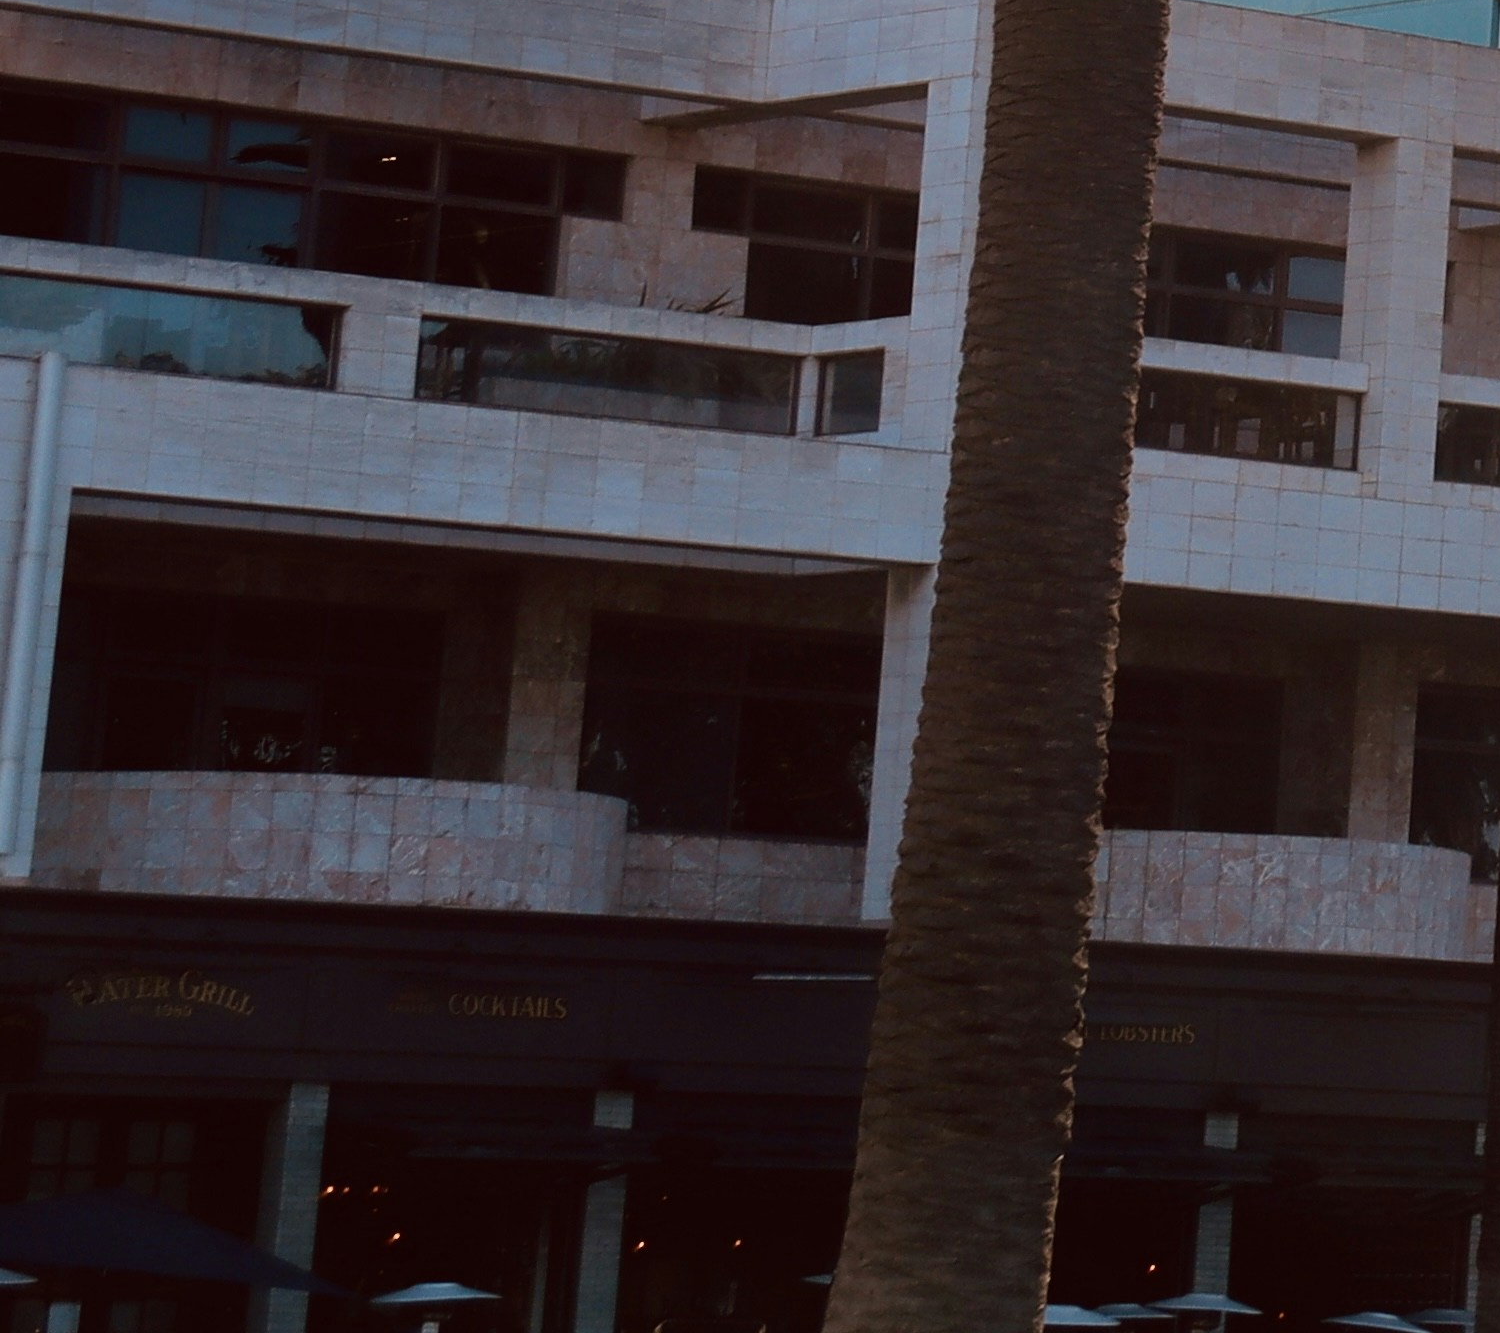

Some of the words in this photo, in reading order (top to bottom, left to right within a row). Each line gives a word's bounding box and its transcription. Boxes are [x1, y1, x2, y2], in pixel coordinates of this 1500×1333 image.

[178, 967, 256, 1016] GRILL
[448, 992, 568, 1020] COCKTAILS
[1099, 1023, 1196, 1044] LOBSTERS
